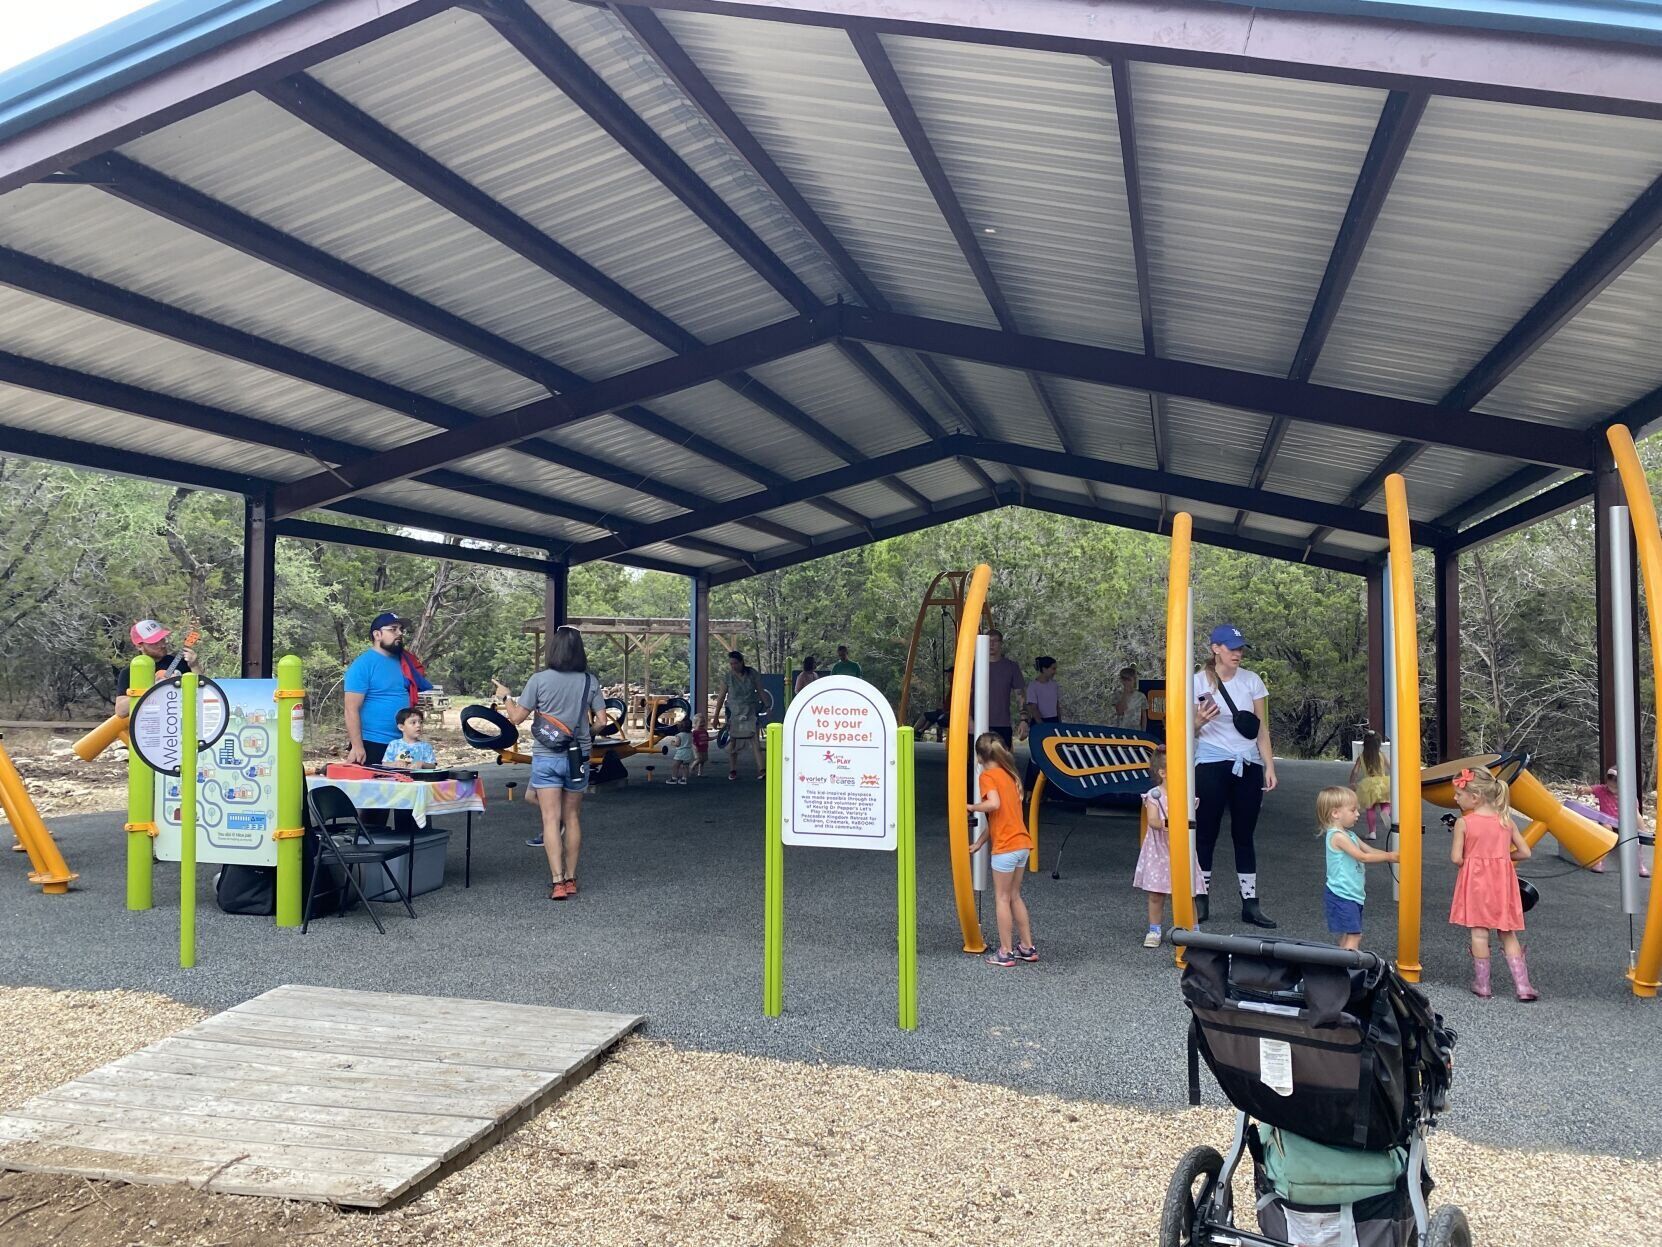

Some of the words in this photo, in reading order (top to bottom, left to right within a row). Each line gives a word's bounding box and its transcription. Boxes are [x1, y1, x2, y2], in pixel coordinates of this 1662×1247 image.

[811, 705, 869, 716] Welcome
[163, 691, 178, 765] Welcome
[817, 719, 829, 728] to
[834, 720, 862, 730] your
[806, 731, 873, 742] Playspace!
